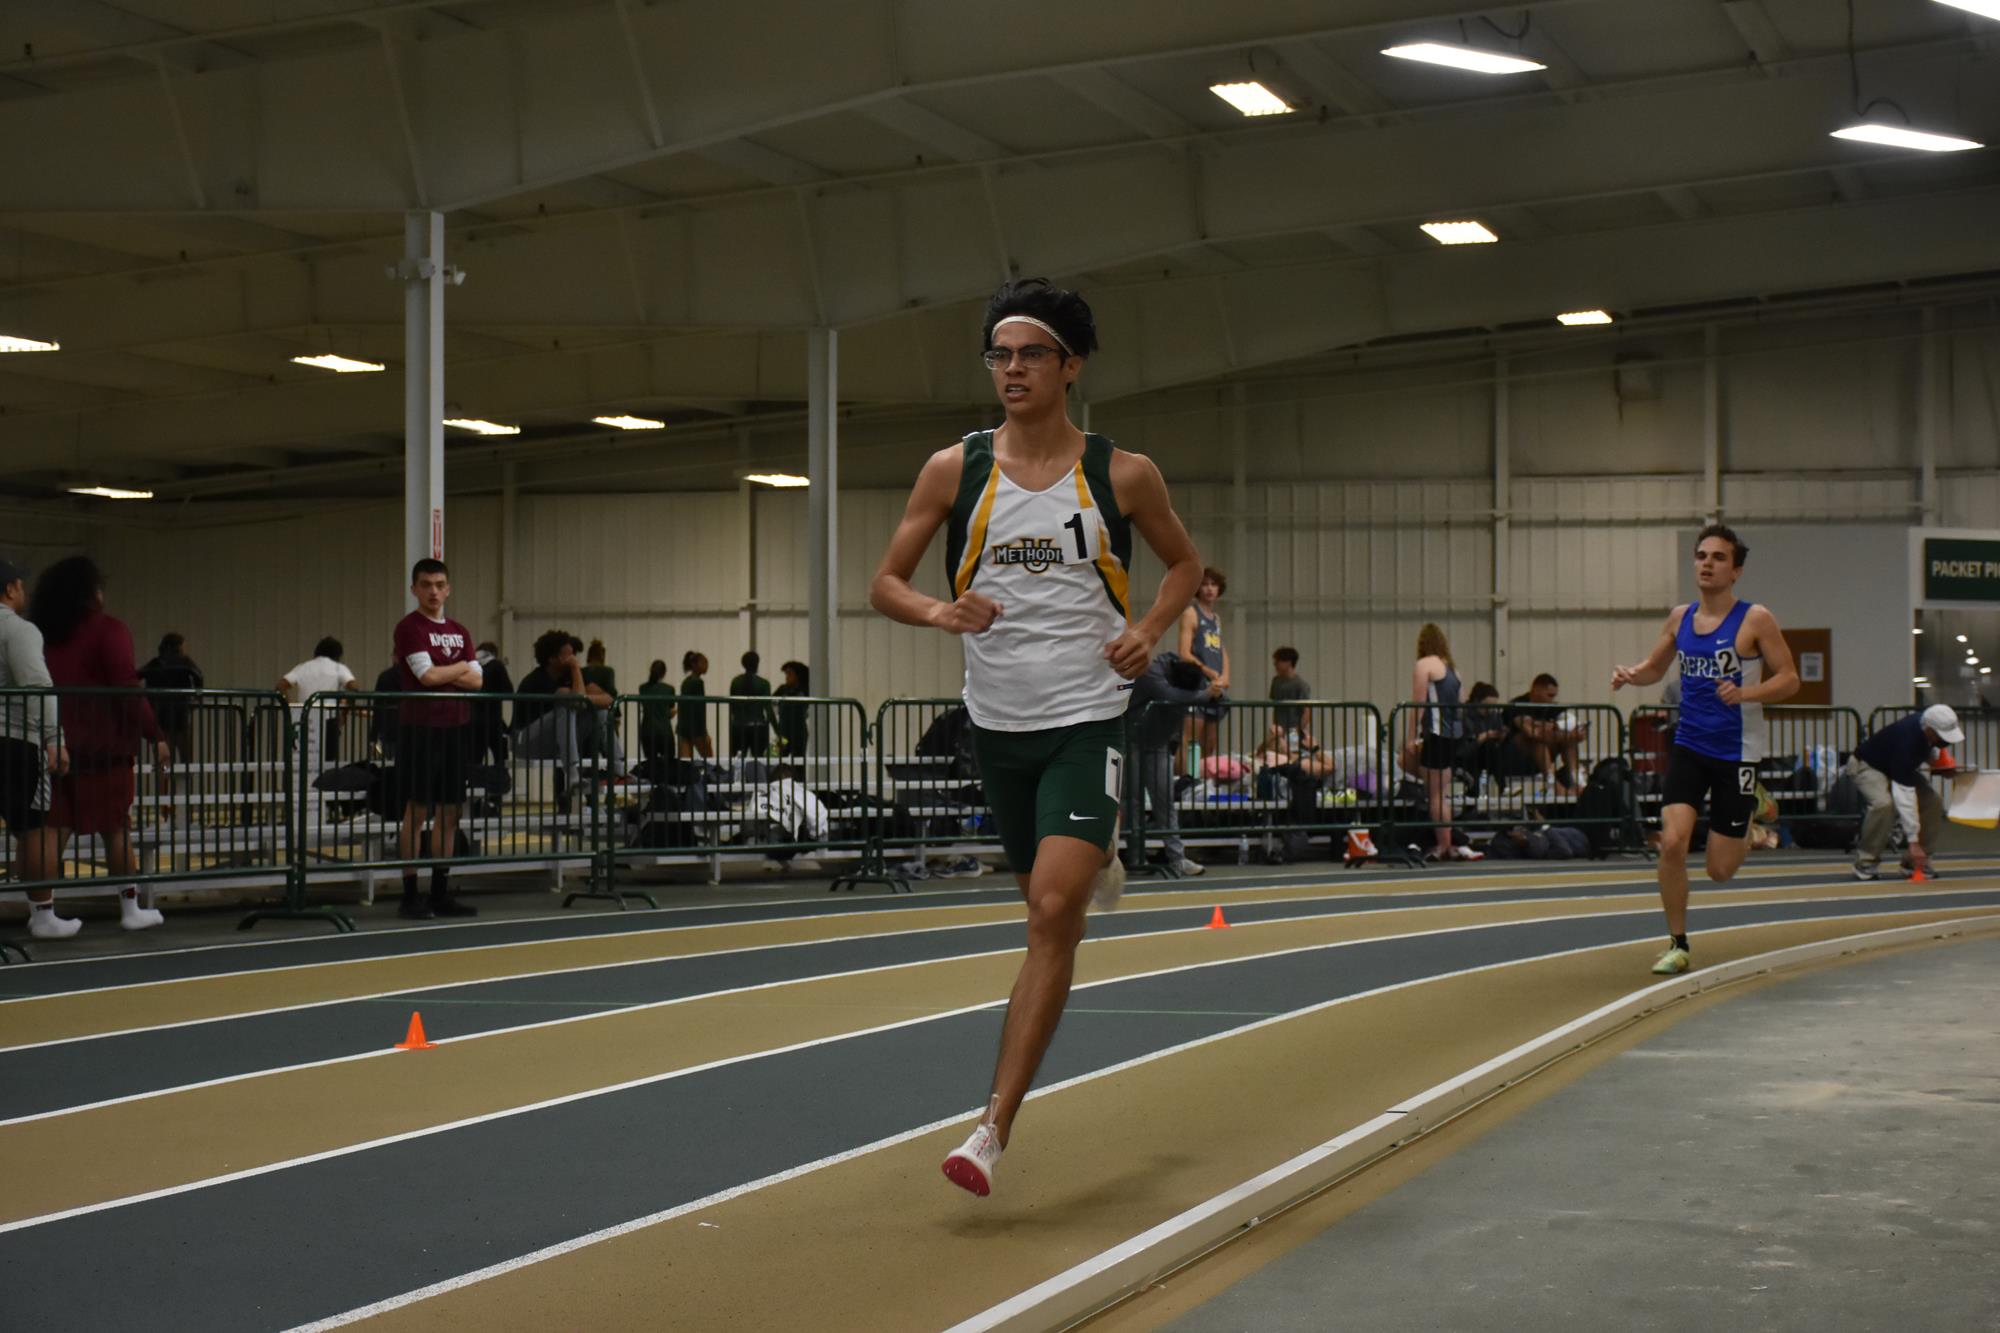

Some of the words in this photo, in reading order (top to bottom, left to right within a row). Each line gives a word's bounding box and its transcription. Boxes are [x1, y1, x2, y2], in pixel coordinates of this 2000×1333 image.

[1064, 513, 1087, 559] 1
[996, 546, 1062, 563] METHODI
[1931, 560, 1983, 578] PACKET
[1984, 561, 2000, 579] PI
[1678, 650, 1733, 679] BERE
[1718, 651, 1736, 674] 2
[1740, 768, 1753, 793] 2
